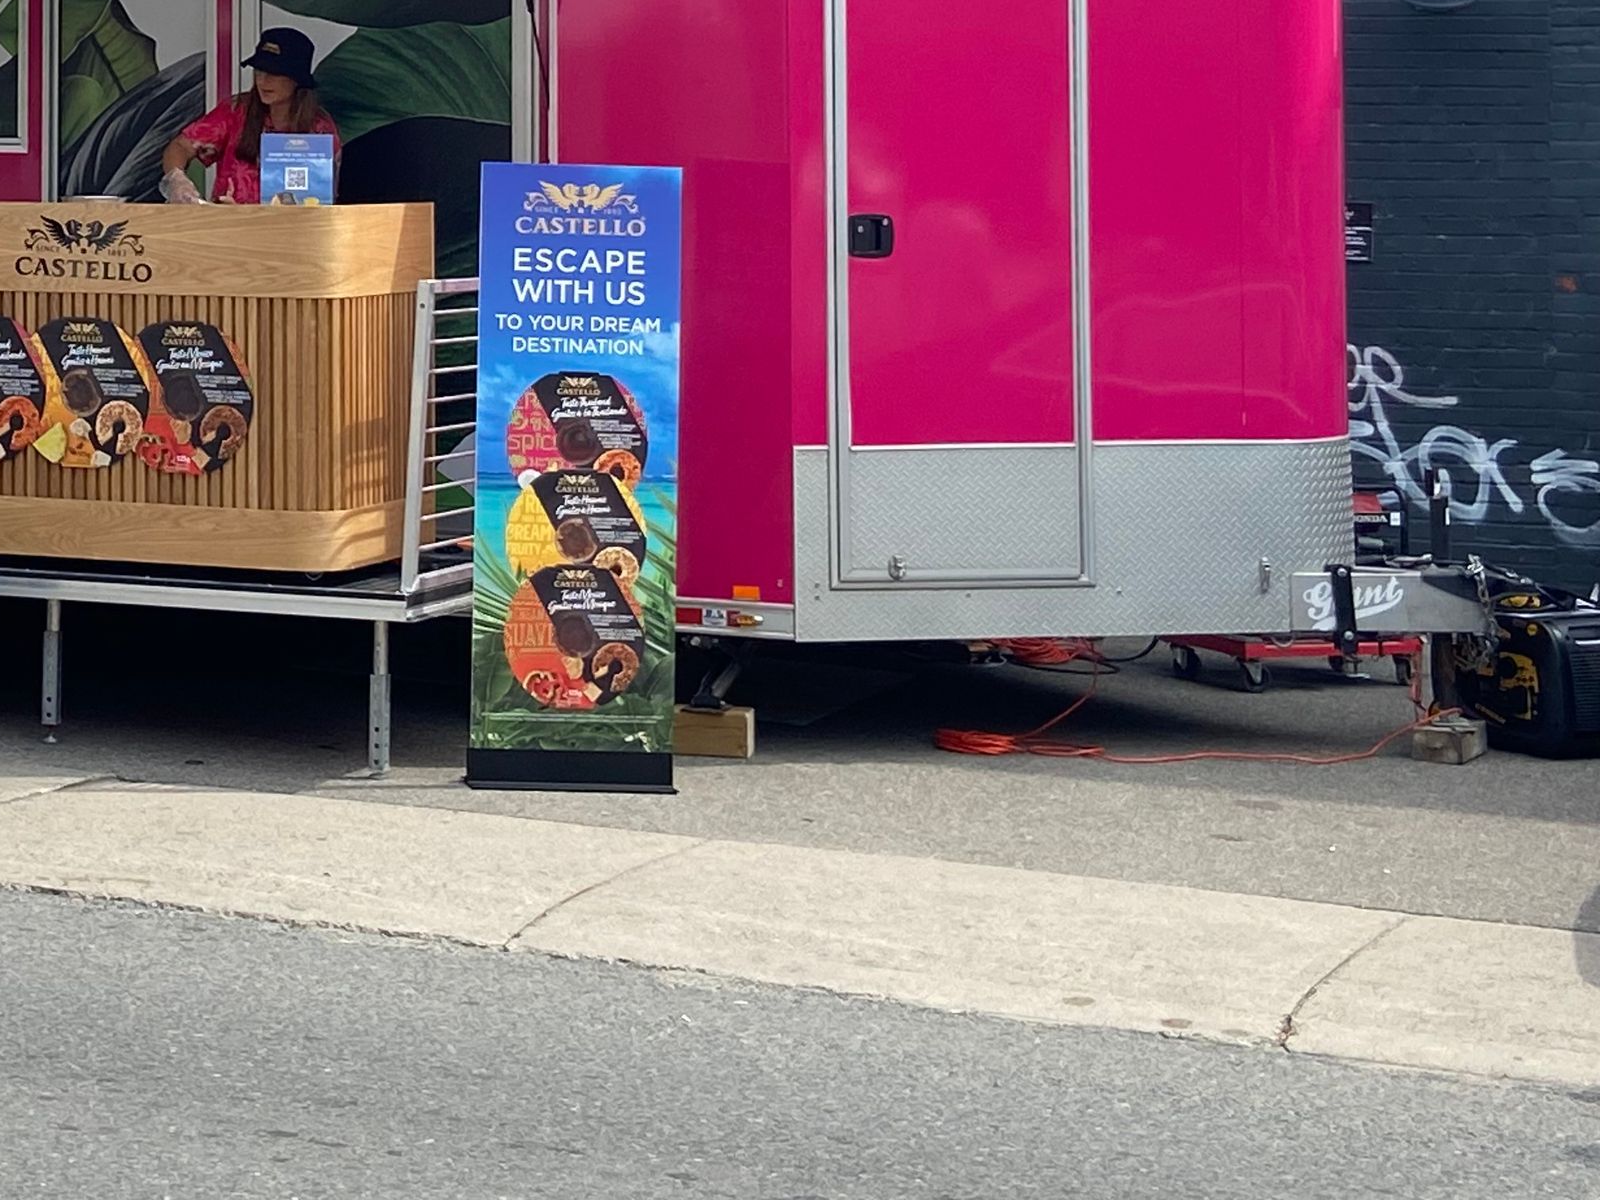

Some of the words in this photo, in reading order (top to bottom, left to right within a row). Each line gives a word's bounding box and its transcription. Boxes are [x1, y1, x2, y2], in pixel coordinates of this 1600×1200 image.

[515, 216, 647, 237] CASTELLO
[15, 256, 153, 283] CASTELLO
[513, 247, 647, 275] ESCAPE
[512, 278, 594, 304] WITH
[605, 281, 646, 306] US
[495, 313, 523, 330] TO
[528, 315, 584, 332] YOUR
[590, 316, 662, 333] DREAM
[161, 337, 205, 346] CASTELLO
[512, 337, 644, 355] DESTINATION
[557, 388, 601, 396] CASTELLO
[553, 580, 598, 588] CASTELLO
[1303, 576, 1404, 620] Gnt
